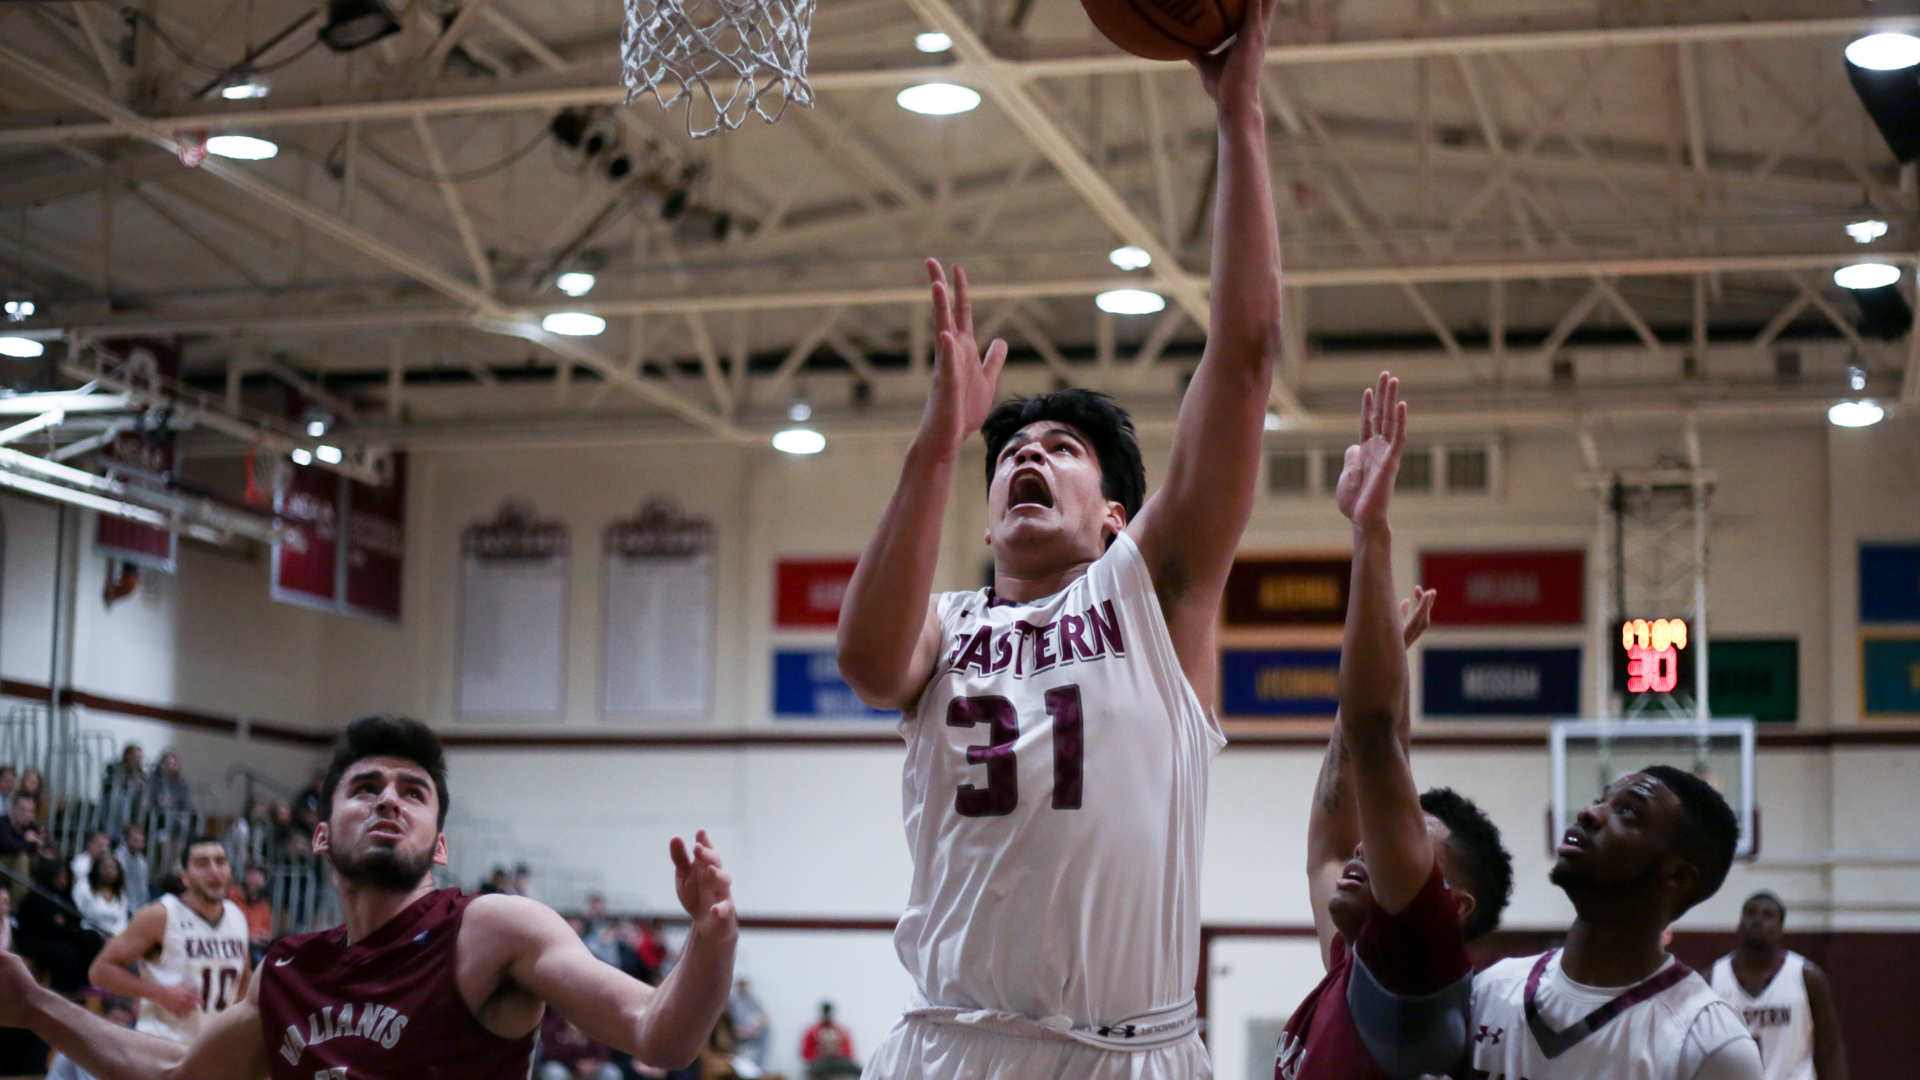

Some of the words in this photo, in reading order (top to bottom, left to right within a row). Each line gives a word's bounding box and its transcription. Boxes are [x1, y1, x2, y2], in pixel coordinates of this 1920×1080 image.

[1627, 643, 1677, 693] 30
[946, 683, 1084, 817] 31
[279, 1003, 408, 1067] VALIANTS
